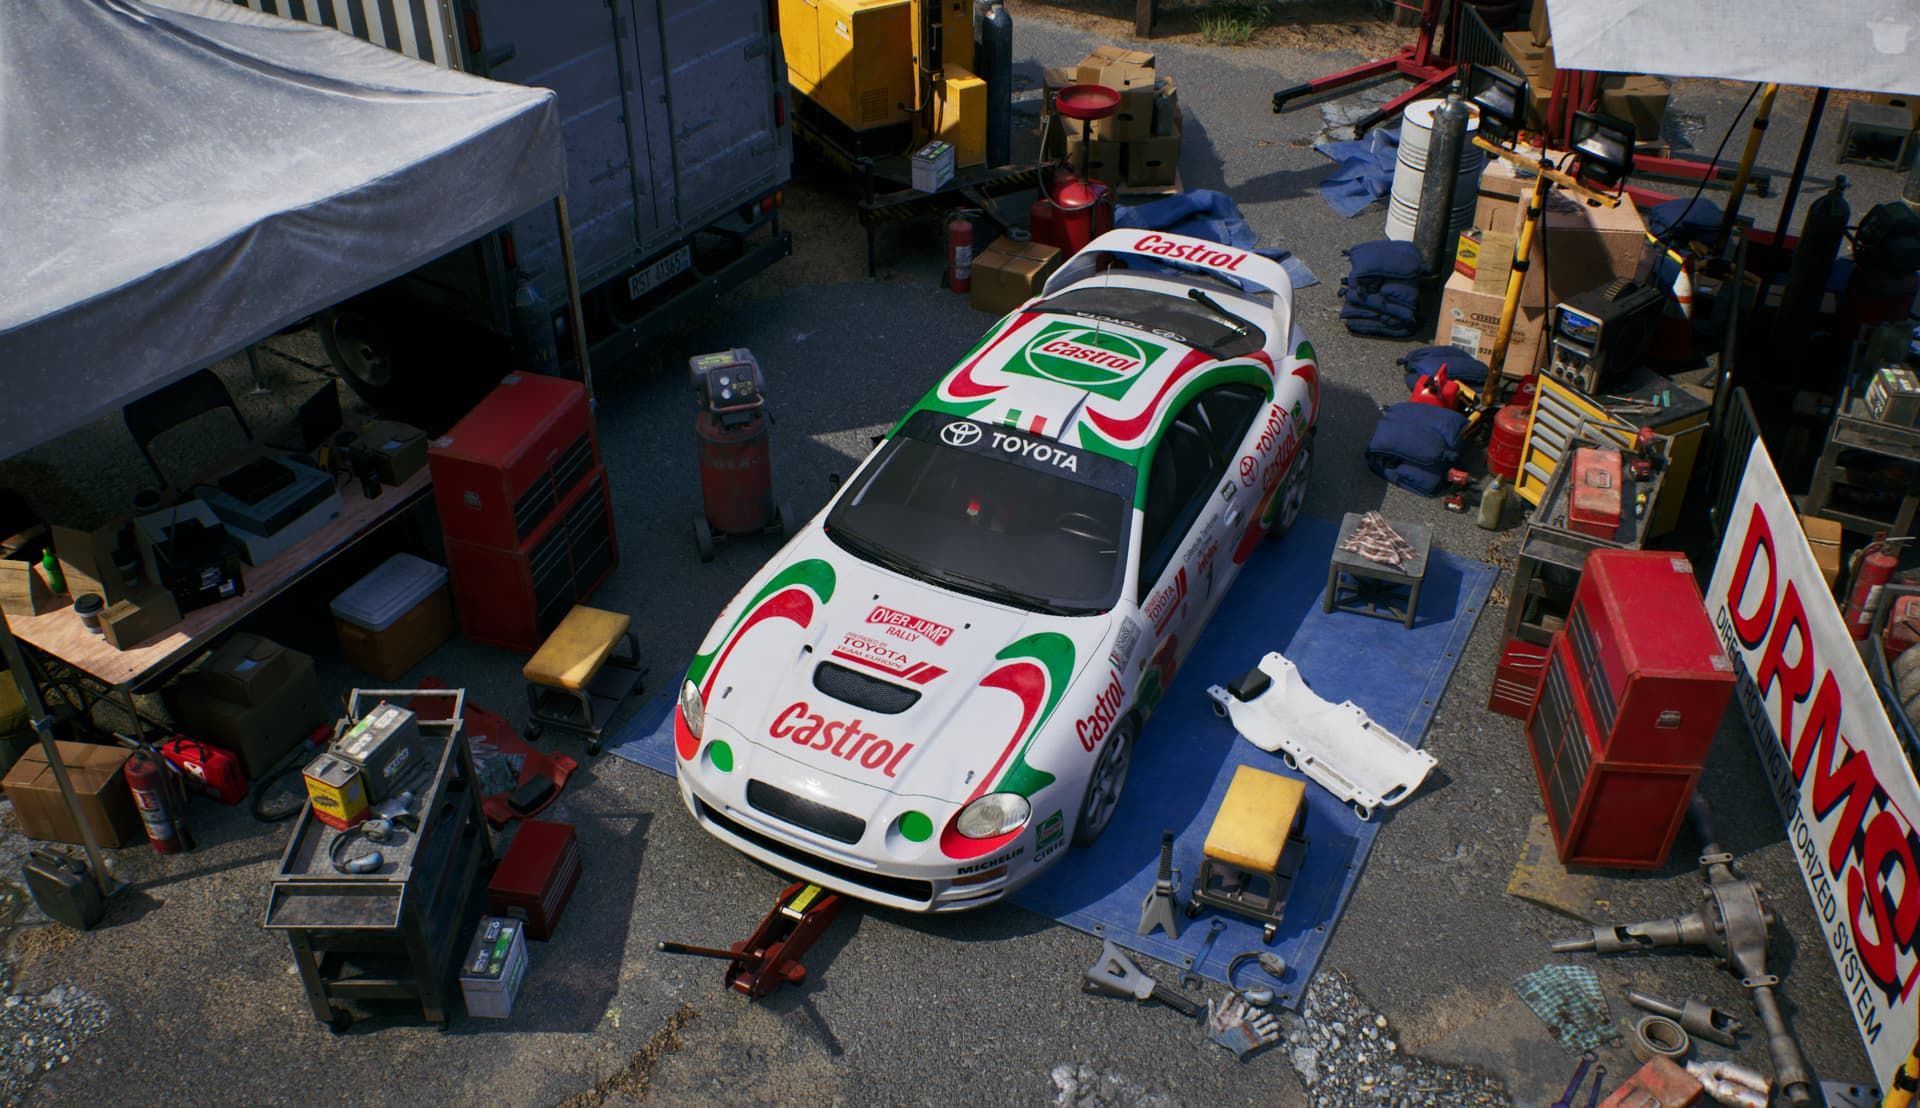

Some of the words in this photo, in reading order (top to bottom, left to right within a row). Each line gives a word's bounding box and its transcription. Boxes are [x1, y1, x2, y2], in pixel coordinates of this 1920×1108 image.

[1134, 234, 1248, 271] Castrol
[1076, 311, 1144, 330] TOYOTA
[1042, 341, 1140, 371] Castrol
[1255, 403, 1289, 457] TOYOTA
[991, 432, 1078, 472] TOYOTA
[1148, 586, 1175, 621] TOYOTA
[870, 608, 911, 627] OVER
[909, 620, 950, 642] JUMP
[885, 626, 920, 642] RALLY
[837, 645, 863, 657] TEAM
[864, 653, 903, 669] EUROPE
[843, 637, 908, 663] TOYOTA
[1075, 669, 1126, 752] Castrol
[769, 701, 915, 778] Castrol
[1716, 604, 1748, 684] DIRECT
[1743, 675, 1781, 778] ROLLING
[1777, 772, 1837, 924] MOTORIZED
[1833, 921, 1882, 1045] SYSTEM
[958, 846, 1025, 875] MICHELIN
